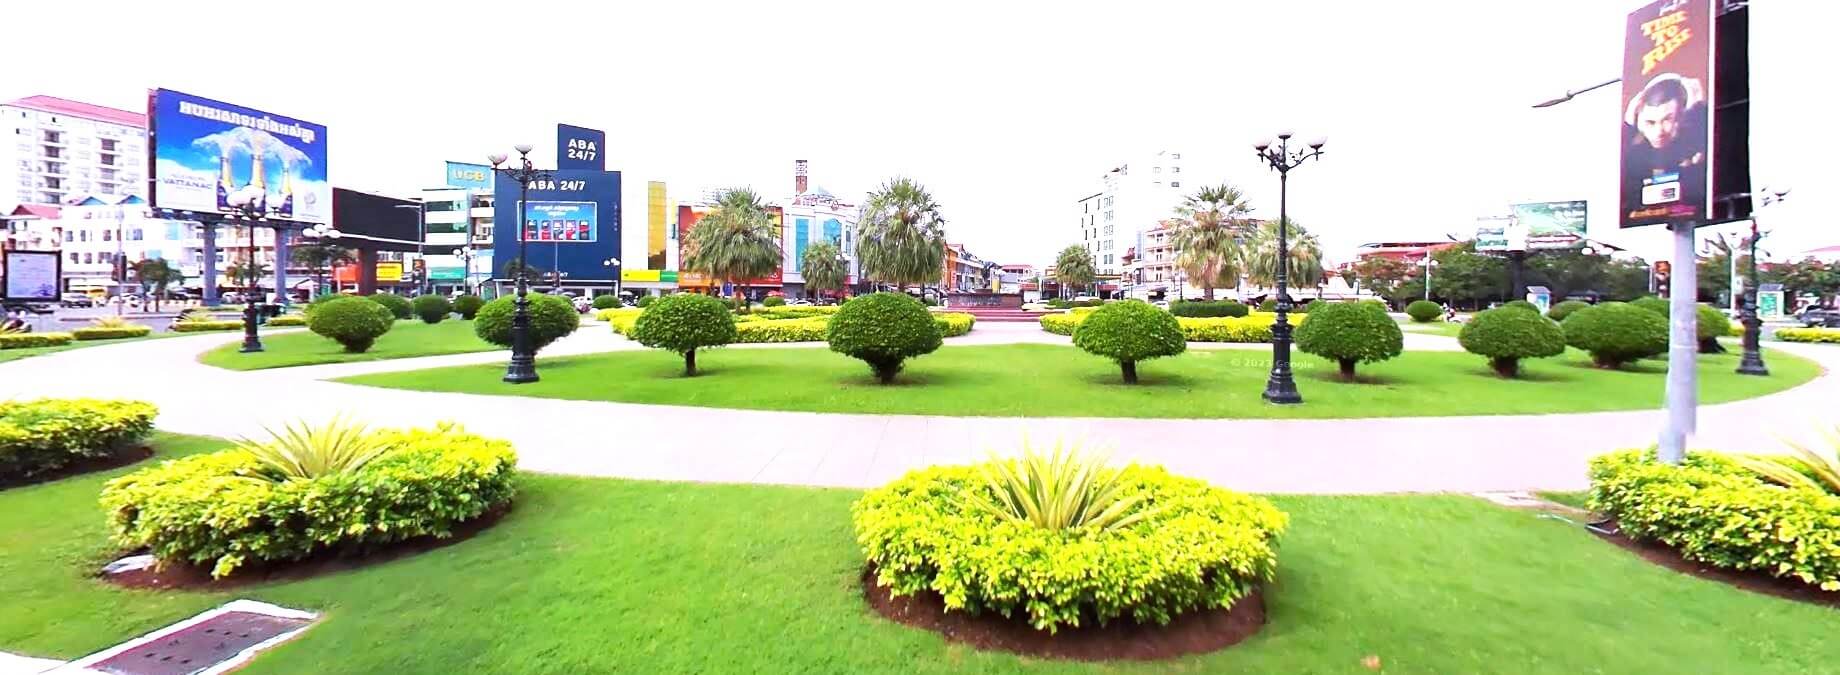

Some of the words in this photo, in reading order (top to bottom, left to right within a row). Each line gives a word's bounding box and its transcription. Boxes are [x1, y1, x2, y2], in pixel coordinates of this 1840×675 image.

[1640, 11, 1688, 35] TIME
[1651, 24, 1680, 46] TO
[1641, 28, 1693, 75] RISE
[568, 138, 596, 151] ABA
[568, 149, 596, 161] 24/7
[528, 180, 556, 191] ABA
[560, 180, 586, 191] 24/7
